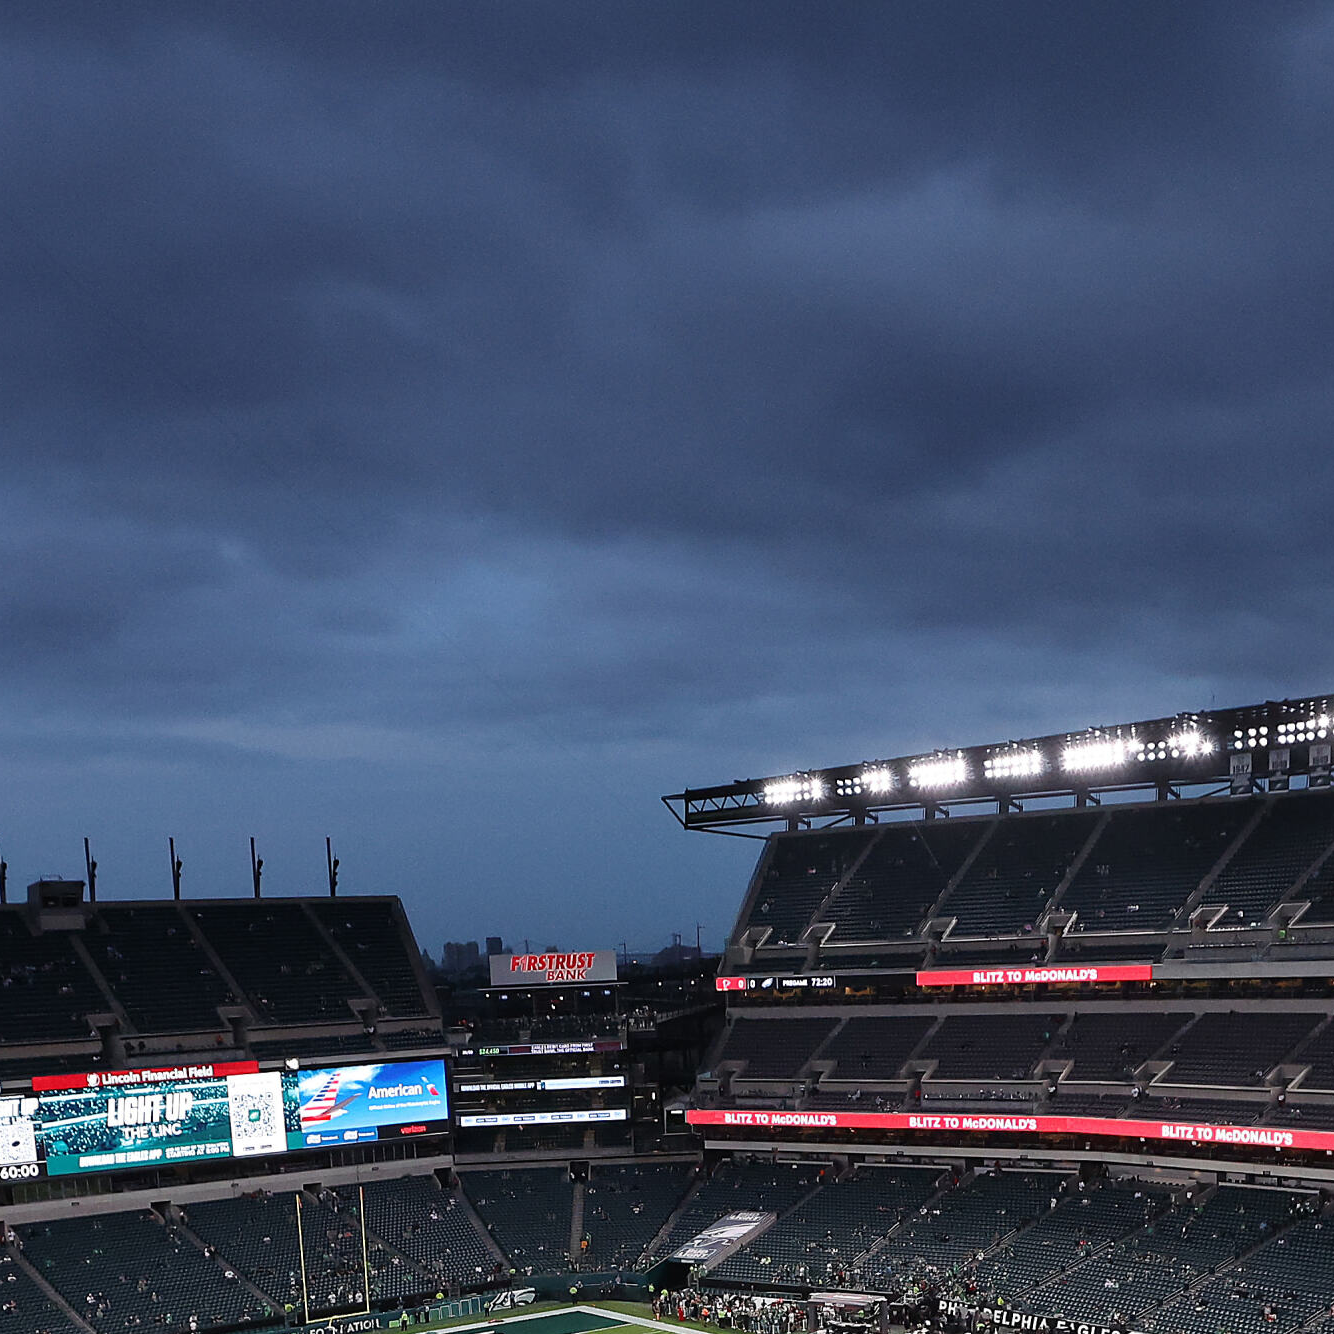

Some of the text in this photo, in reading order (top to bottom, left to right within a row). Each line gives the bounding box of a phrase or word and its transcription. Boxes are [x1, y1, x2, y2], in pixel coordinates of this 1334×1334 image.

[546, 968, 587, 981] BANK
[811, 978, 833, 987] 72:20
[972, 968, 1098, 983] BLITZ TO McDONALD'S
[750, 980, 756, 988] 0
[102, 1065, 214, 1085] Lincoln Financial Field
[367, 1083, 423, 1100] American
[107, 1091, 195, 1127] LIGHT UP
[724, 1112, 837, 1126] BLITZ TO McDONALD'S
[909, 1115, 1037, 1131] BLITZ TO McDONALD'S
[122, 1123, 183, 1140] THE LINC
[400, 1125, 427, 1134] verizon
[1161, 1125, 1293, 1146] BLITZ TO McDONALD'S
[0, 1164, 39, 1180] 60:00
